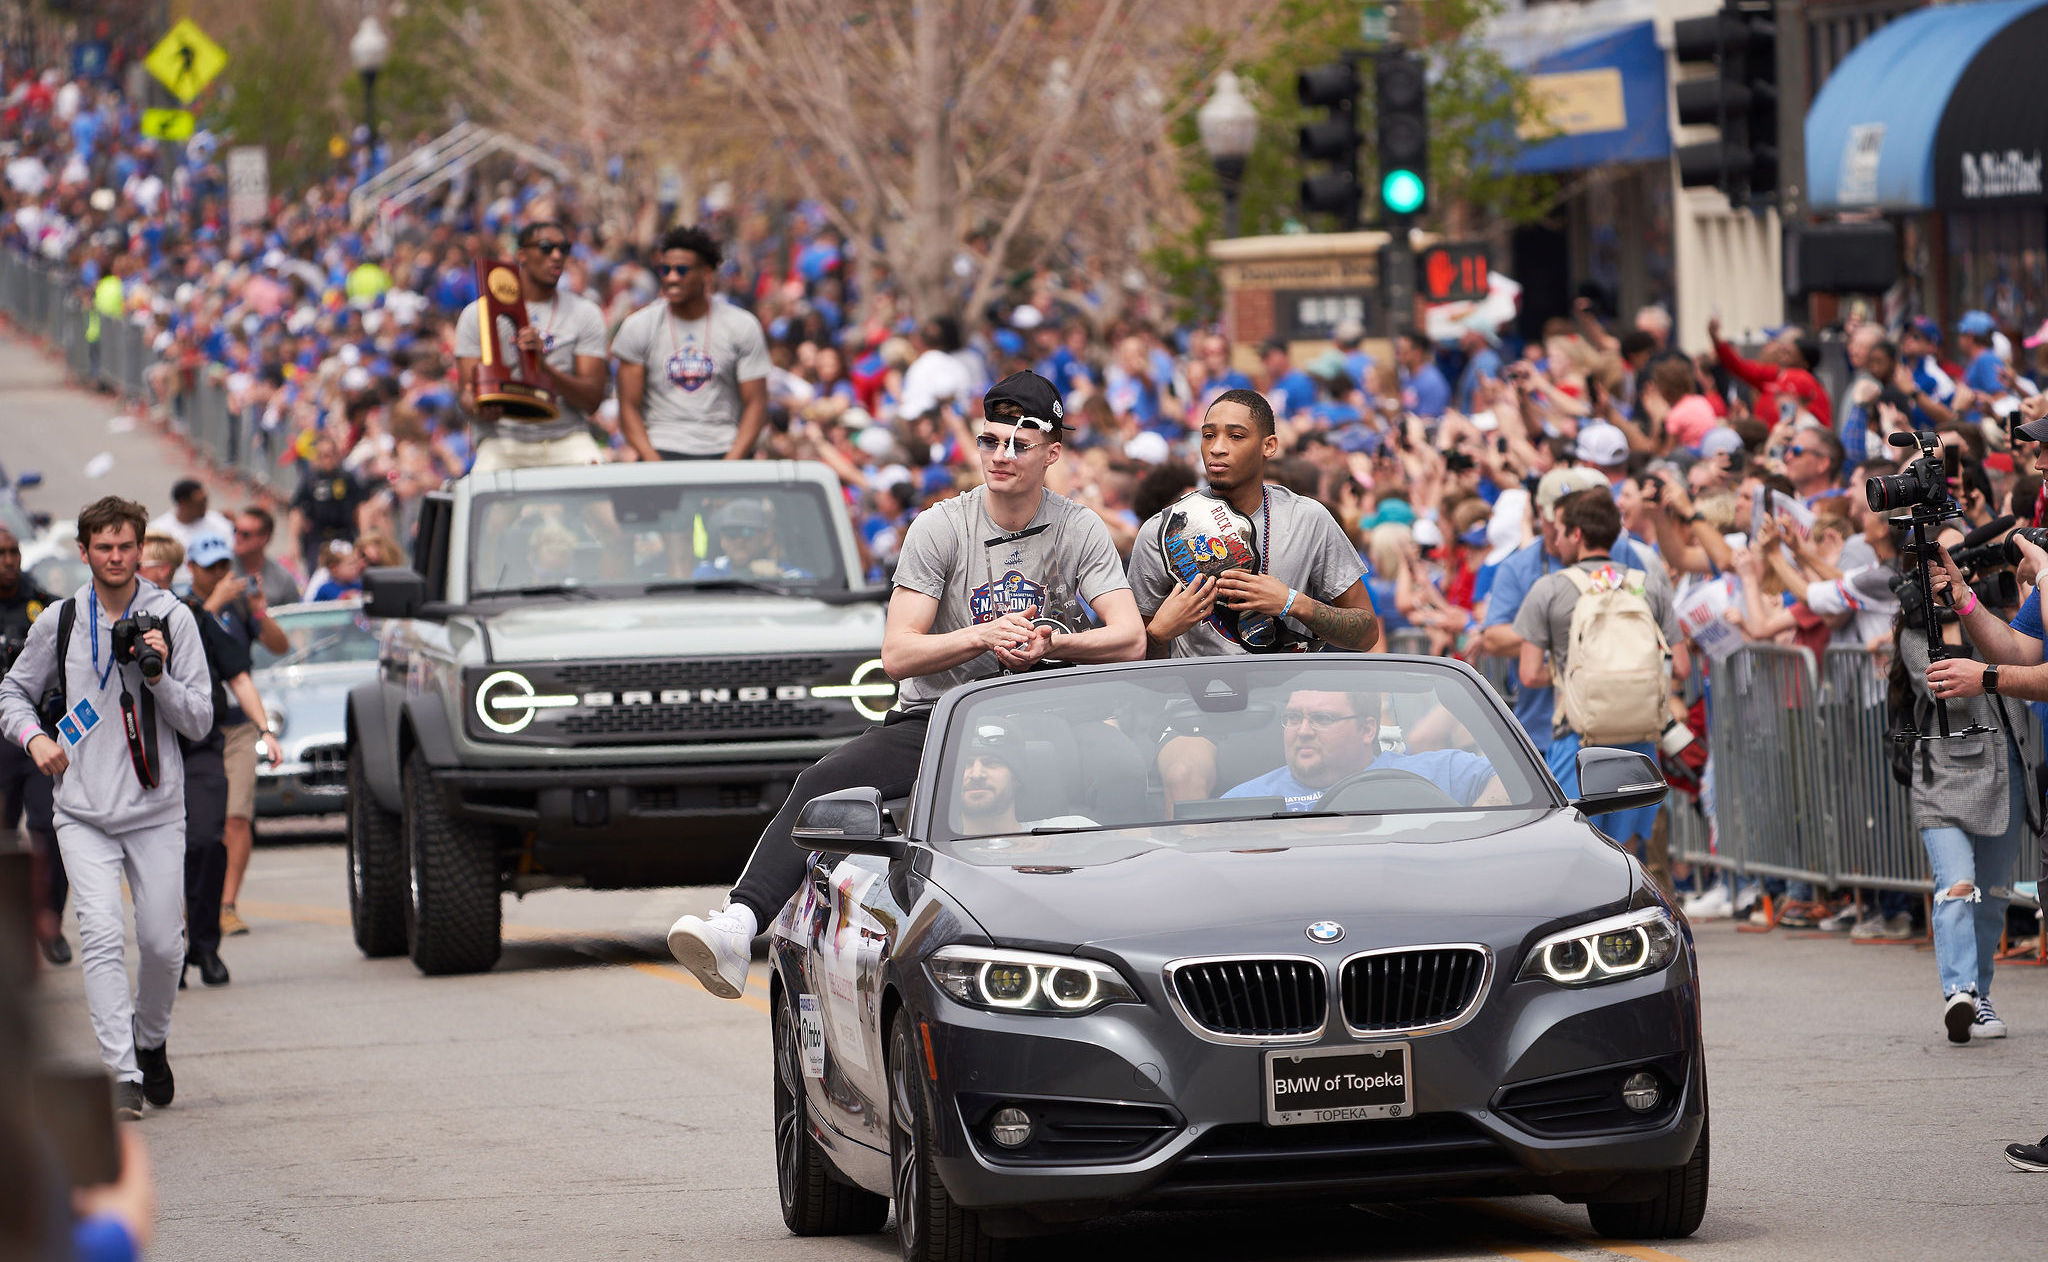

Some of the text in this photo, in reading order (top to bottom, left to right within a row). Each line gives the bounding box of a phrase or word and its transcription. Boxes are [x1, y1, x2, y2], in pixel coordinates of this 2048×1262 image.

[1211, 505, 1252, 566] ROCK CHALK
[583, 685, 807, 707] BRONCO
[126, 712, 136, 739] Canon
[1275, 1072, 1404, 1095] BMW of Topeka
[1314, 1108, 1368, 1122] TOPEKA
